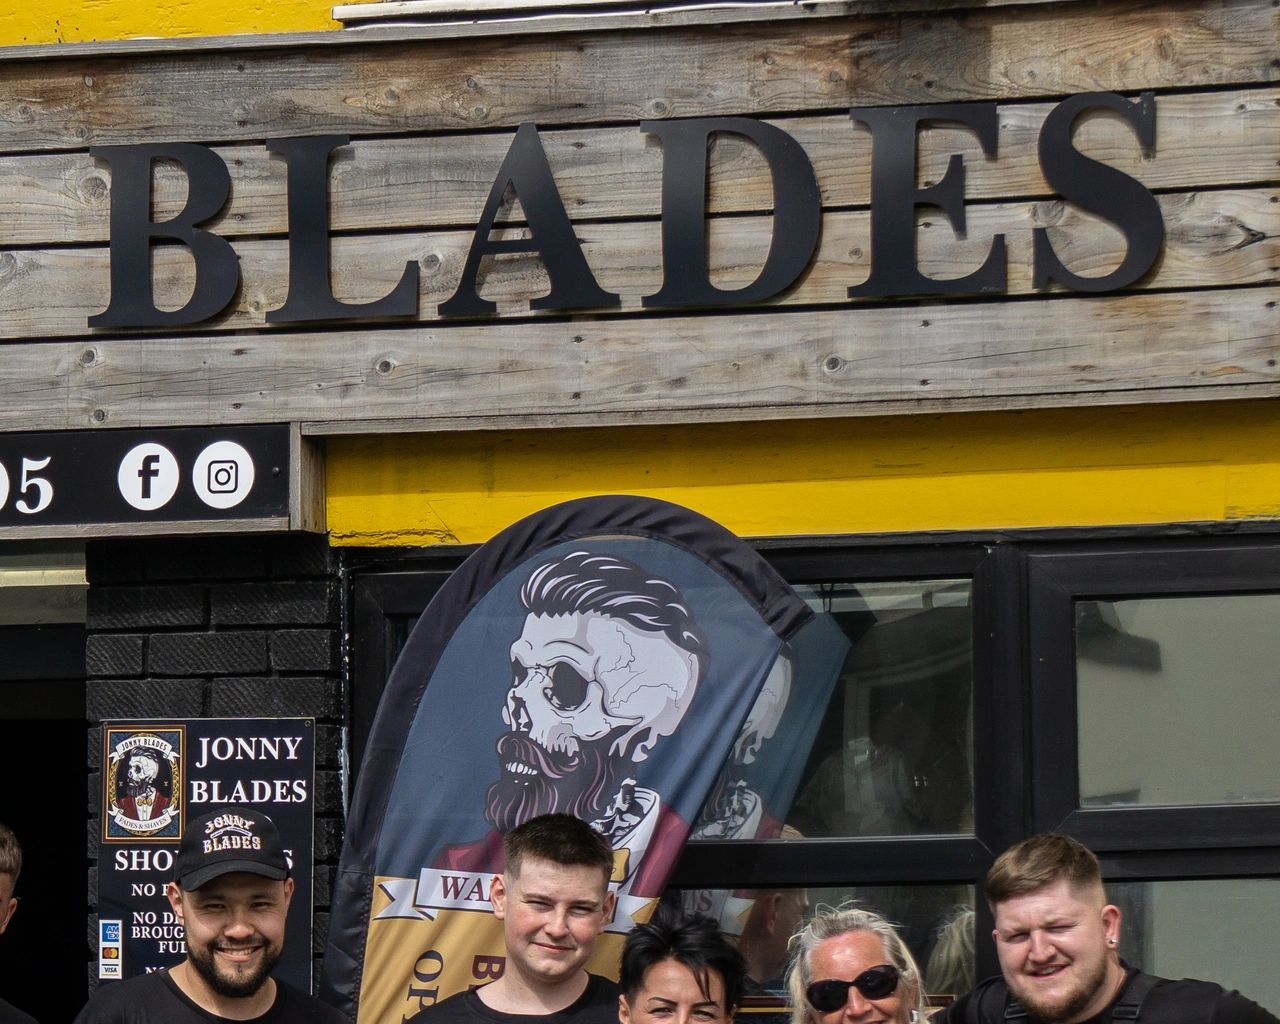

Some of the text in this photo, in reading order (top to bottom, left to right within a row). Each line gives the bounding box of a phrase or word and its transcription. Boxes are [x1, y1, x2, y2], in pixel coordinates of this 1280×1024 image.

[88, 91, 1165, 329] BLADES
[122, 738, 168, 751] JONNY BLADES
[196, 737, 302, 768] JONNY
[190, 780, 307, 803] BLADES
[205, 814, 255, 834] JONNY
[203, 834, 261, 854] BLADES
[115, 849, 180, 871] SHO
[131, 884, 155, 897] NO
[133, 912, 156, 924] NO
[131, 926, 184, 939] BROUG
